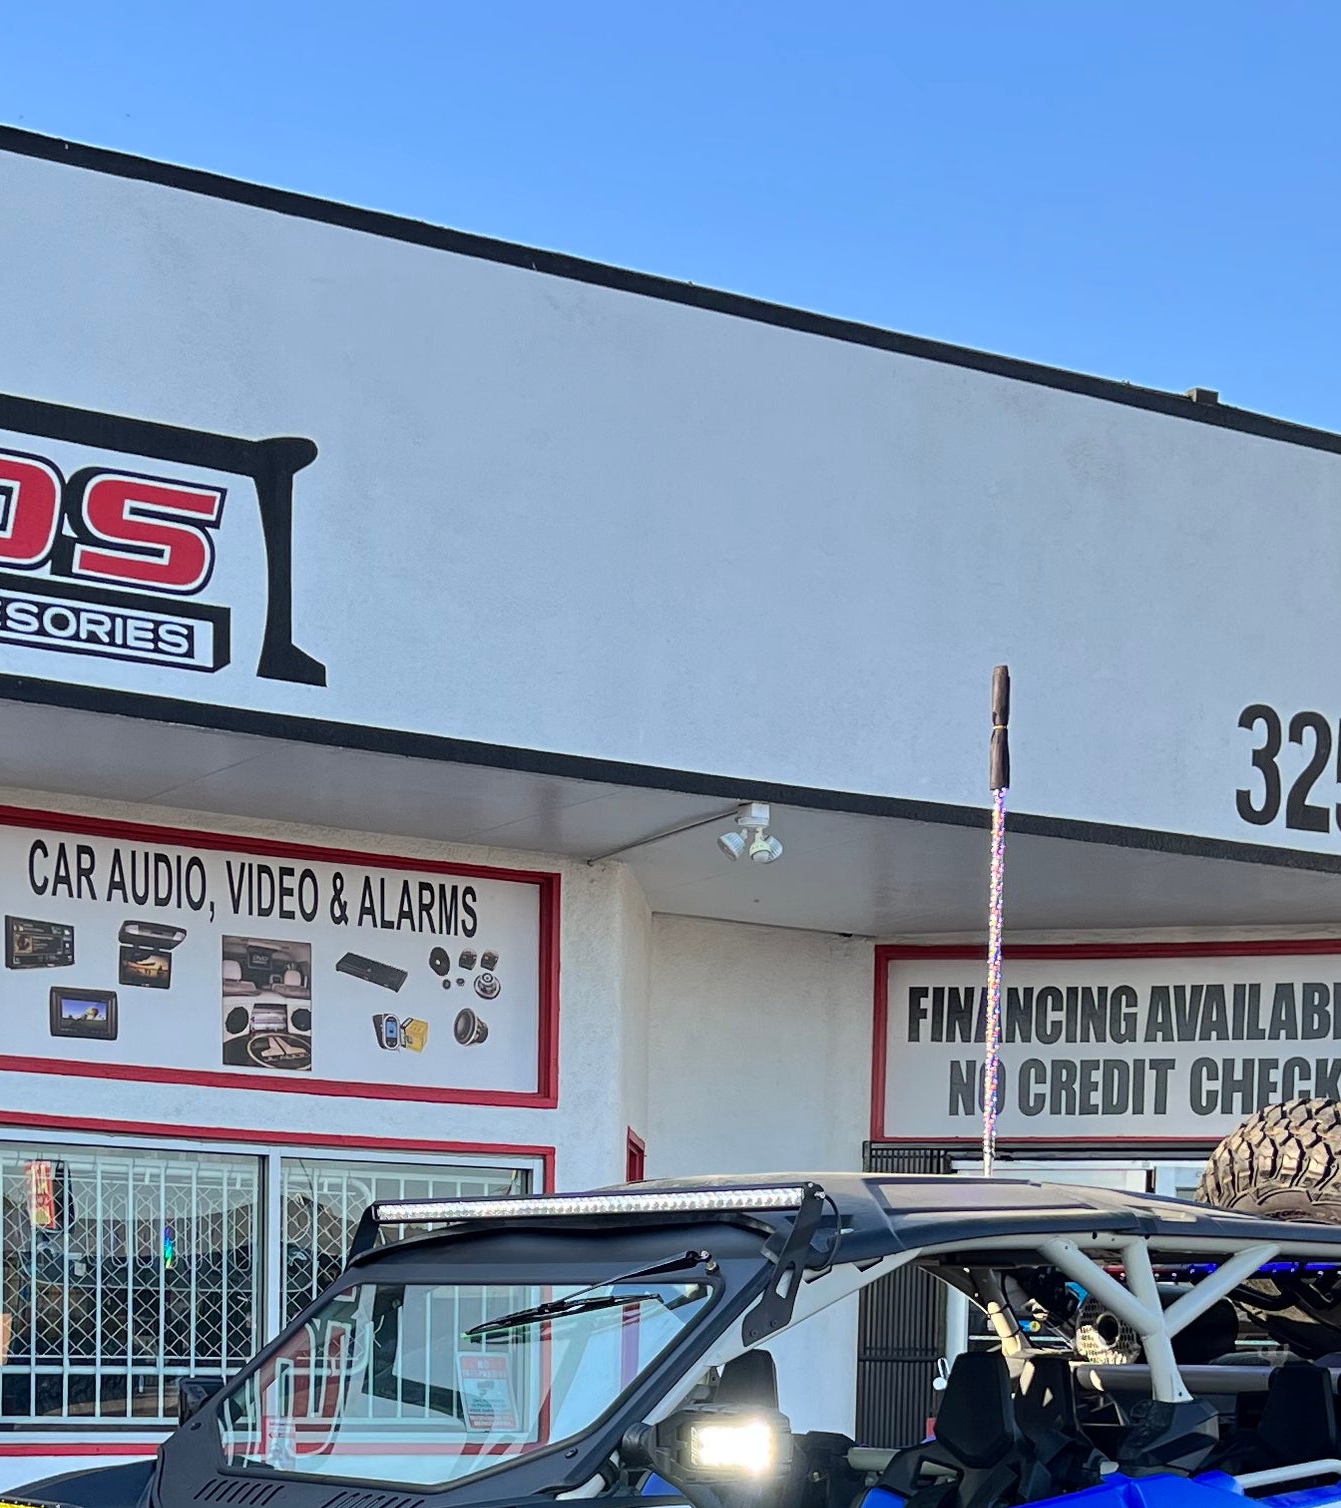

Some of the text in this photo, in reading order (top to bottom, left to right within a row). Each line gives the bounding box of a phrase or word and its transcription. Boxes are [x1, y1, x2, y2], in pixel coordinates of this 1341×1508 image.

[28, 838, 478, 938] CAR AUDIO, VIDEO & ALARMS
[907, 984, 1139, 1045] FINANCING
[948, 1058, 1007, 1117] NO
[1017, 1057, 1177, 1117] CREDIT
